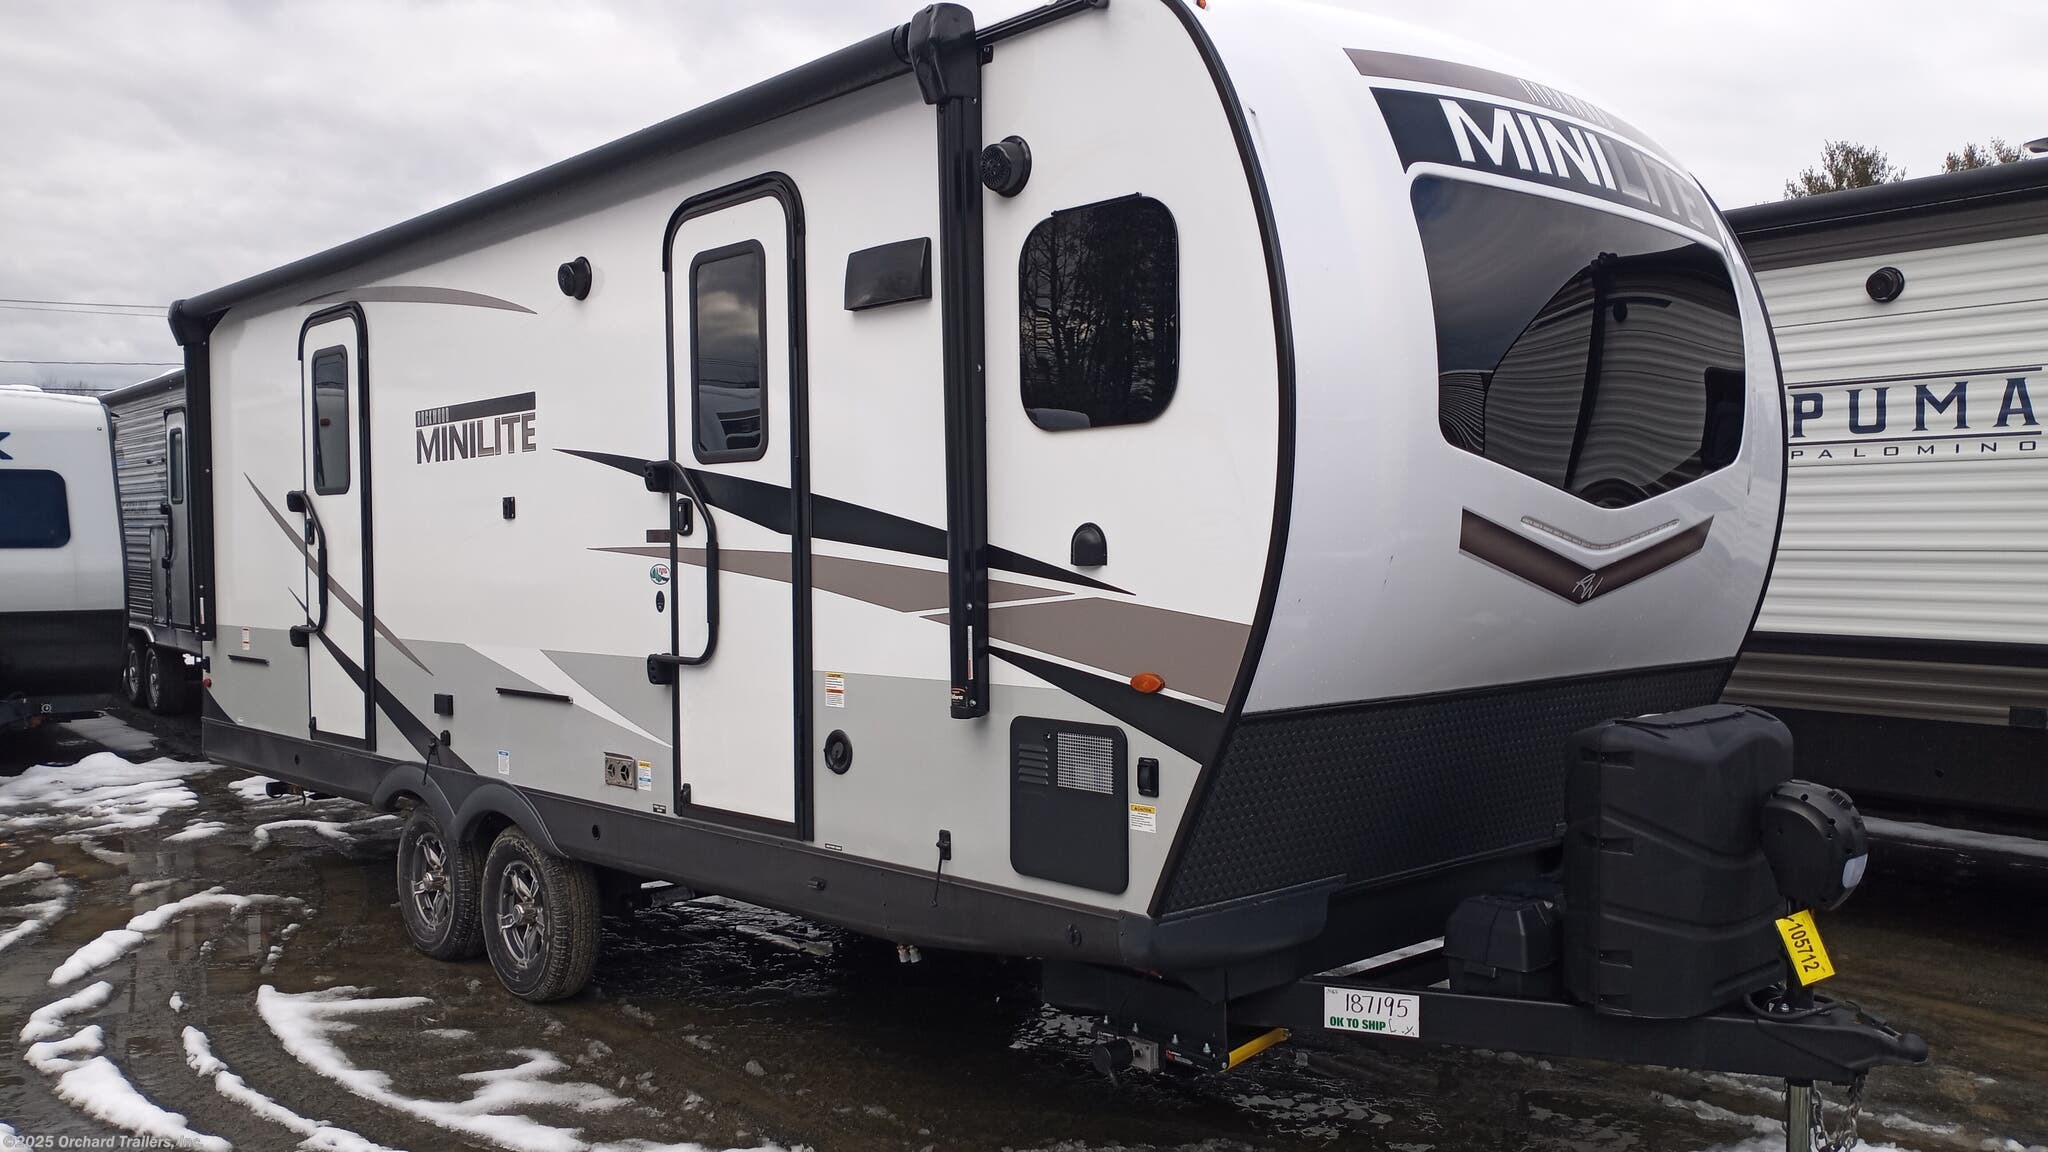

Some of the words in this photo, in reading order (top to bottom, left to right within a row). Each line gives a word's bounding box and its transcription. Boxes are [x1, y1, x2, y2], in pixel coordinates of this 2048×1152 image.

[1438, 98, 1705, 230] MINILITE
[1789, 377, 2040, 438] PUMA
[416, 411, 537, 464] MINILITE
[1791, 440, 2037, 460] PALOMINO
[1788, 923, 1820, 973] 105712
[1329, 1016, 1344, 1028] OK
[1347, 1018, 1359, 1029] TO
[1362, 1019, 1386, 1031] SHIP
[1346, 993, 1412, 1018] 187195
